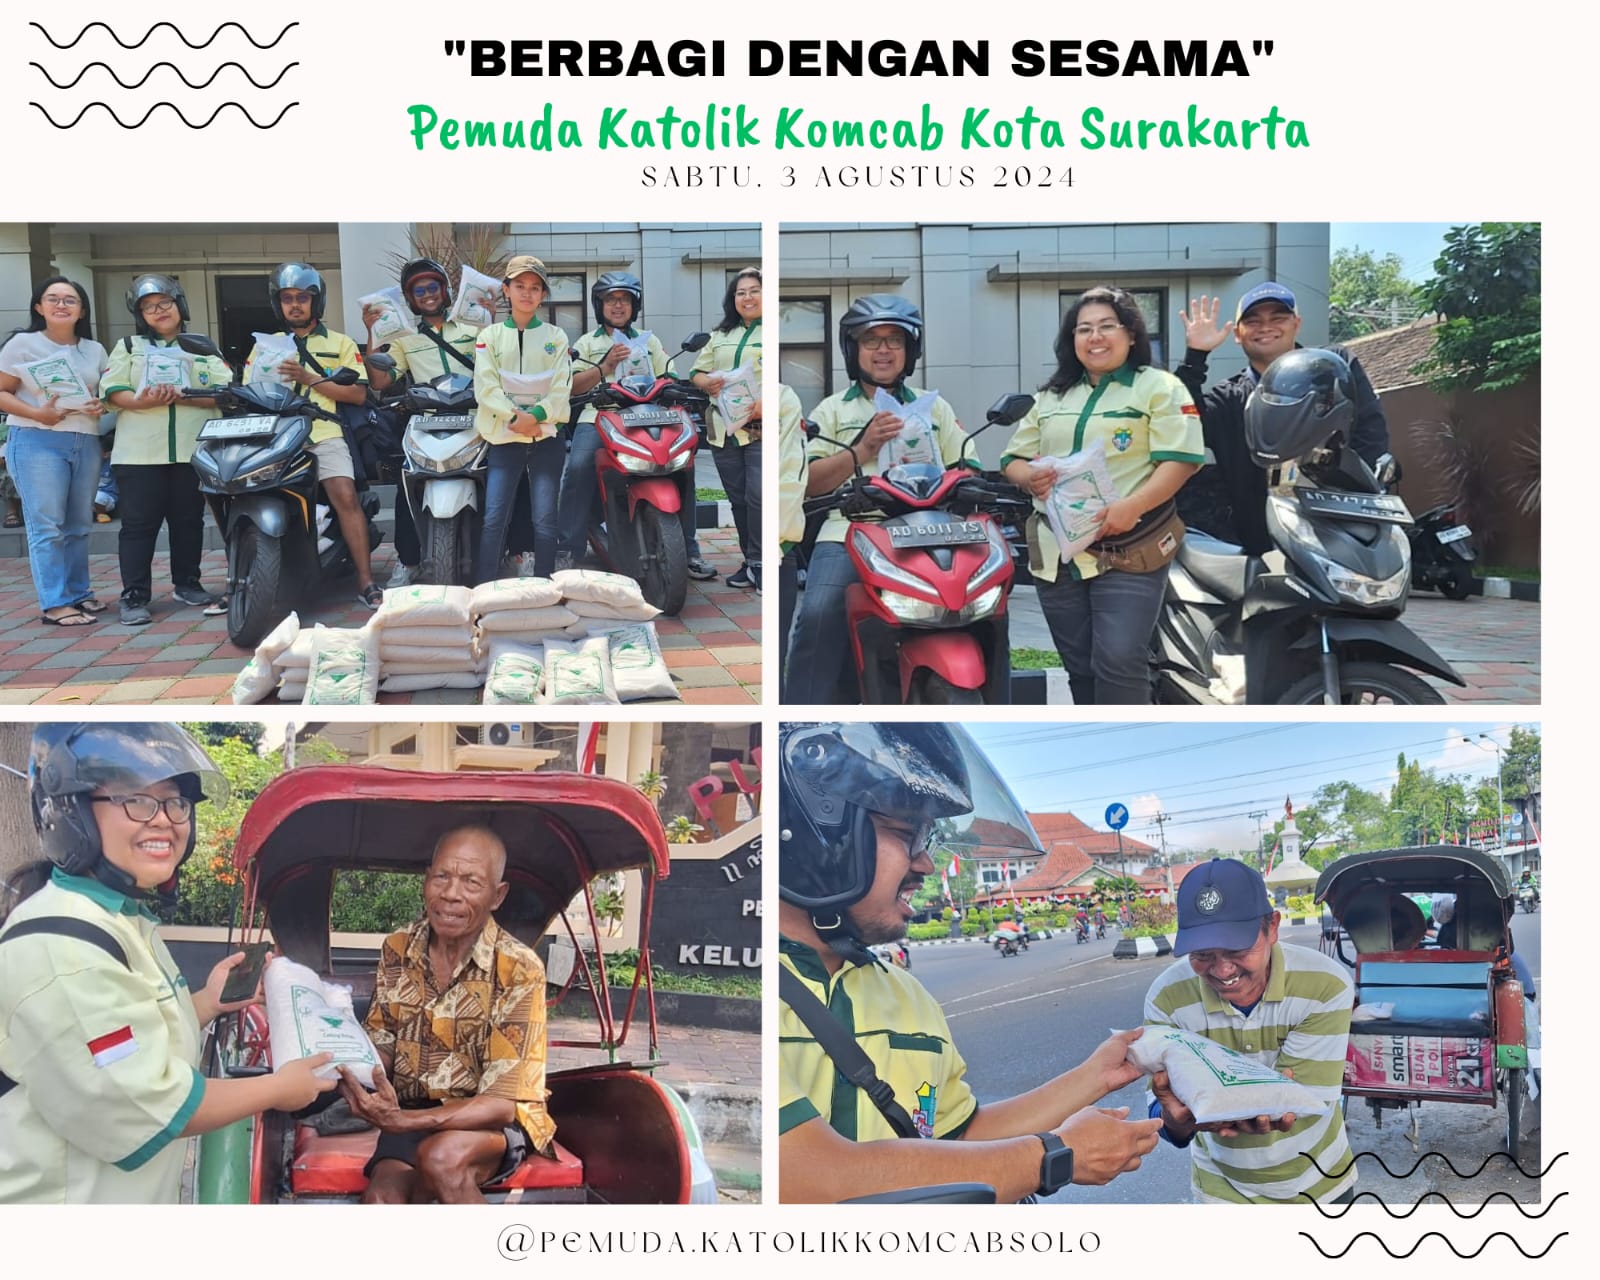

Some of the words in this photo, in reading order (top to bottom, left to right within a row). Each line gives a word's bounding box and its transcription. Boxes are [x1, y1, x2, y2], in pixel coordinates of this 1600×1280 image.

[892, 527, 912, 537] AD
[917, 524, 953, 535] 6011
[960, 522, 979, 532] YS
[1457, 1058, 1480, 1088] 21
